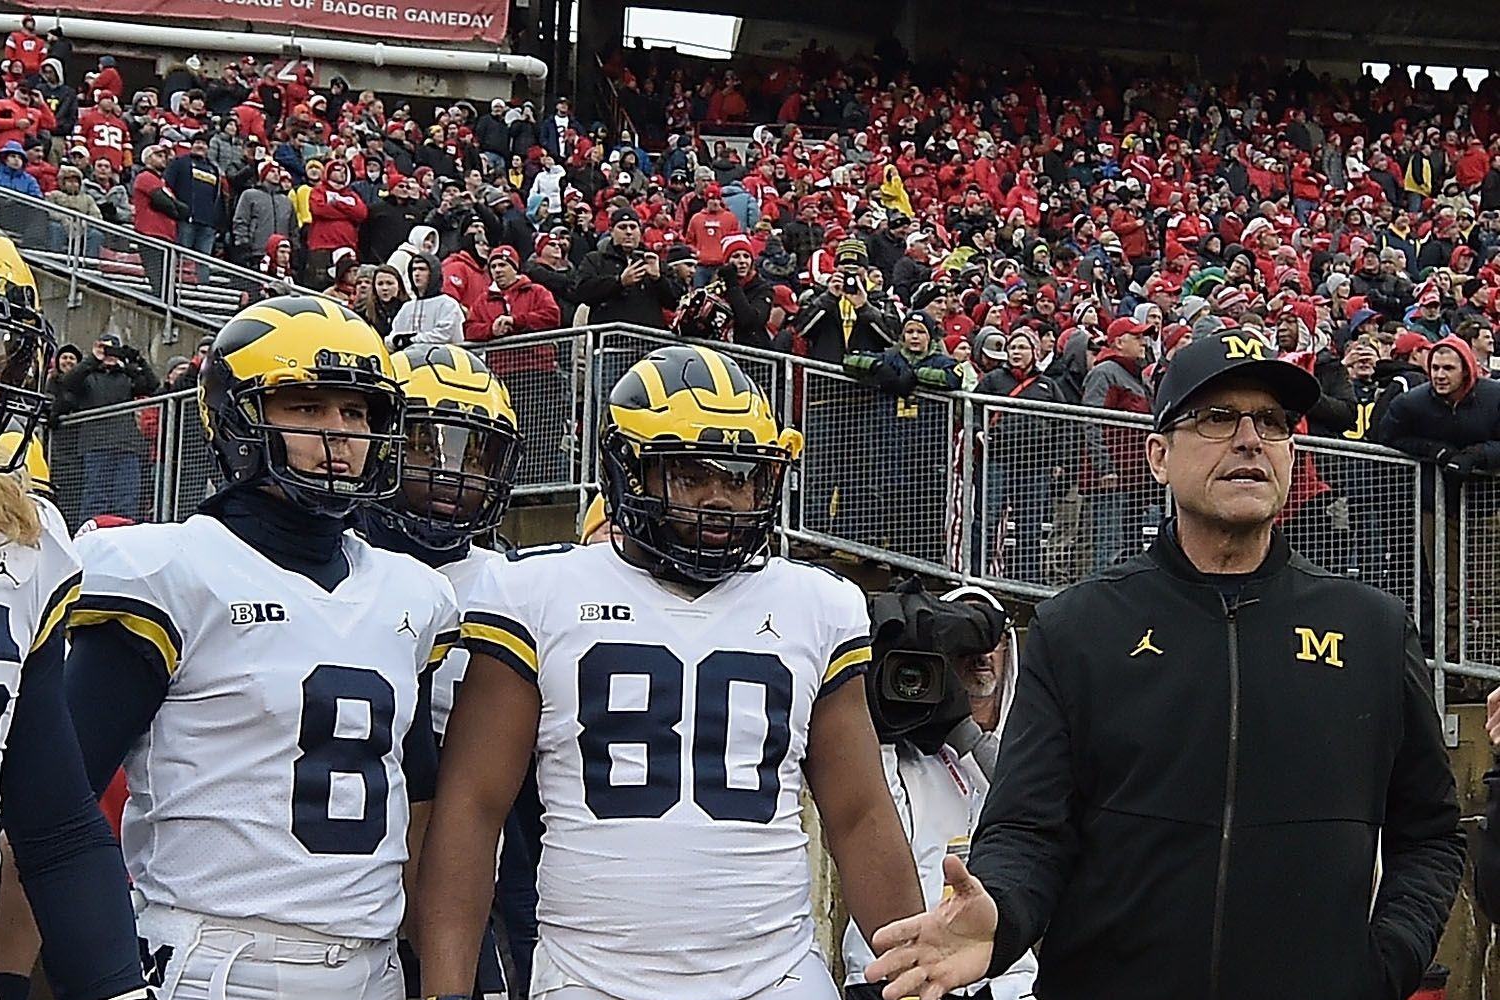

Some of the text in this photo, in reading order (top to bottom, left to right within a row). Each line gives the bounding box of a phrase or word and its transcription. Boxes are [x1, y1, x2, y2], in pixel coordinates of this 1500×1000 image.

[322, 1, 397, 20] BADGER
[404, 8, 494, 28] GAMEDAY
[93, 124, 122, 151] 32
[339, 353, 358, 367] M
[1221, 336, 1267, 361] M
[457, 402, 474, 413] M
[723, 430, 740, 444] M
[1294, 627, 1344, 668] M
[577, 642, 793, 823] 80
[291, 664, 397, 855] 8
